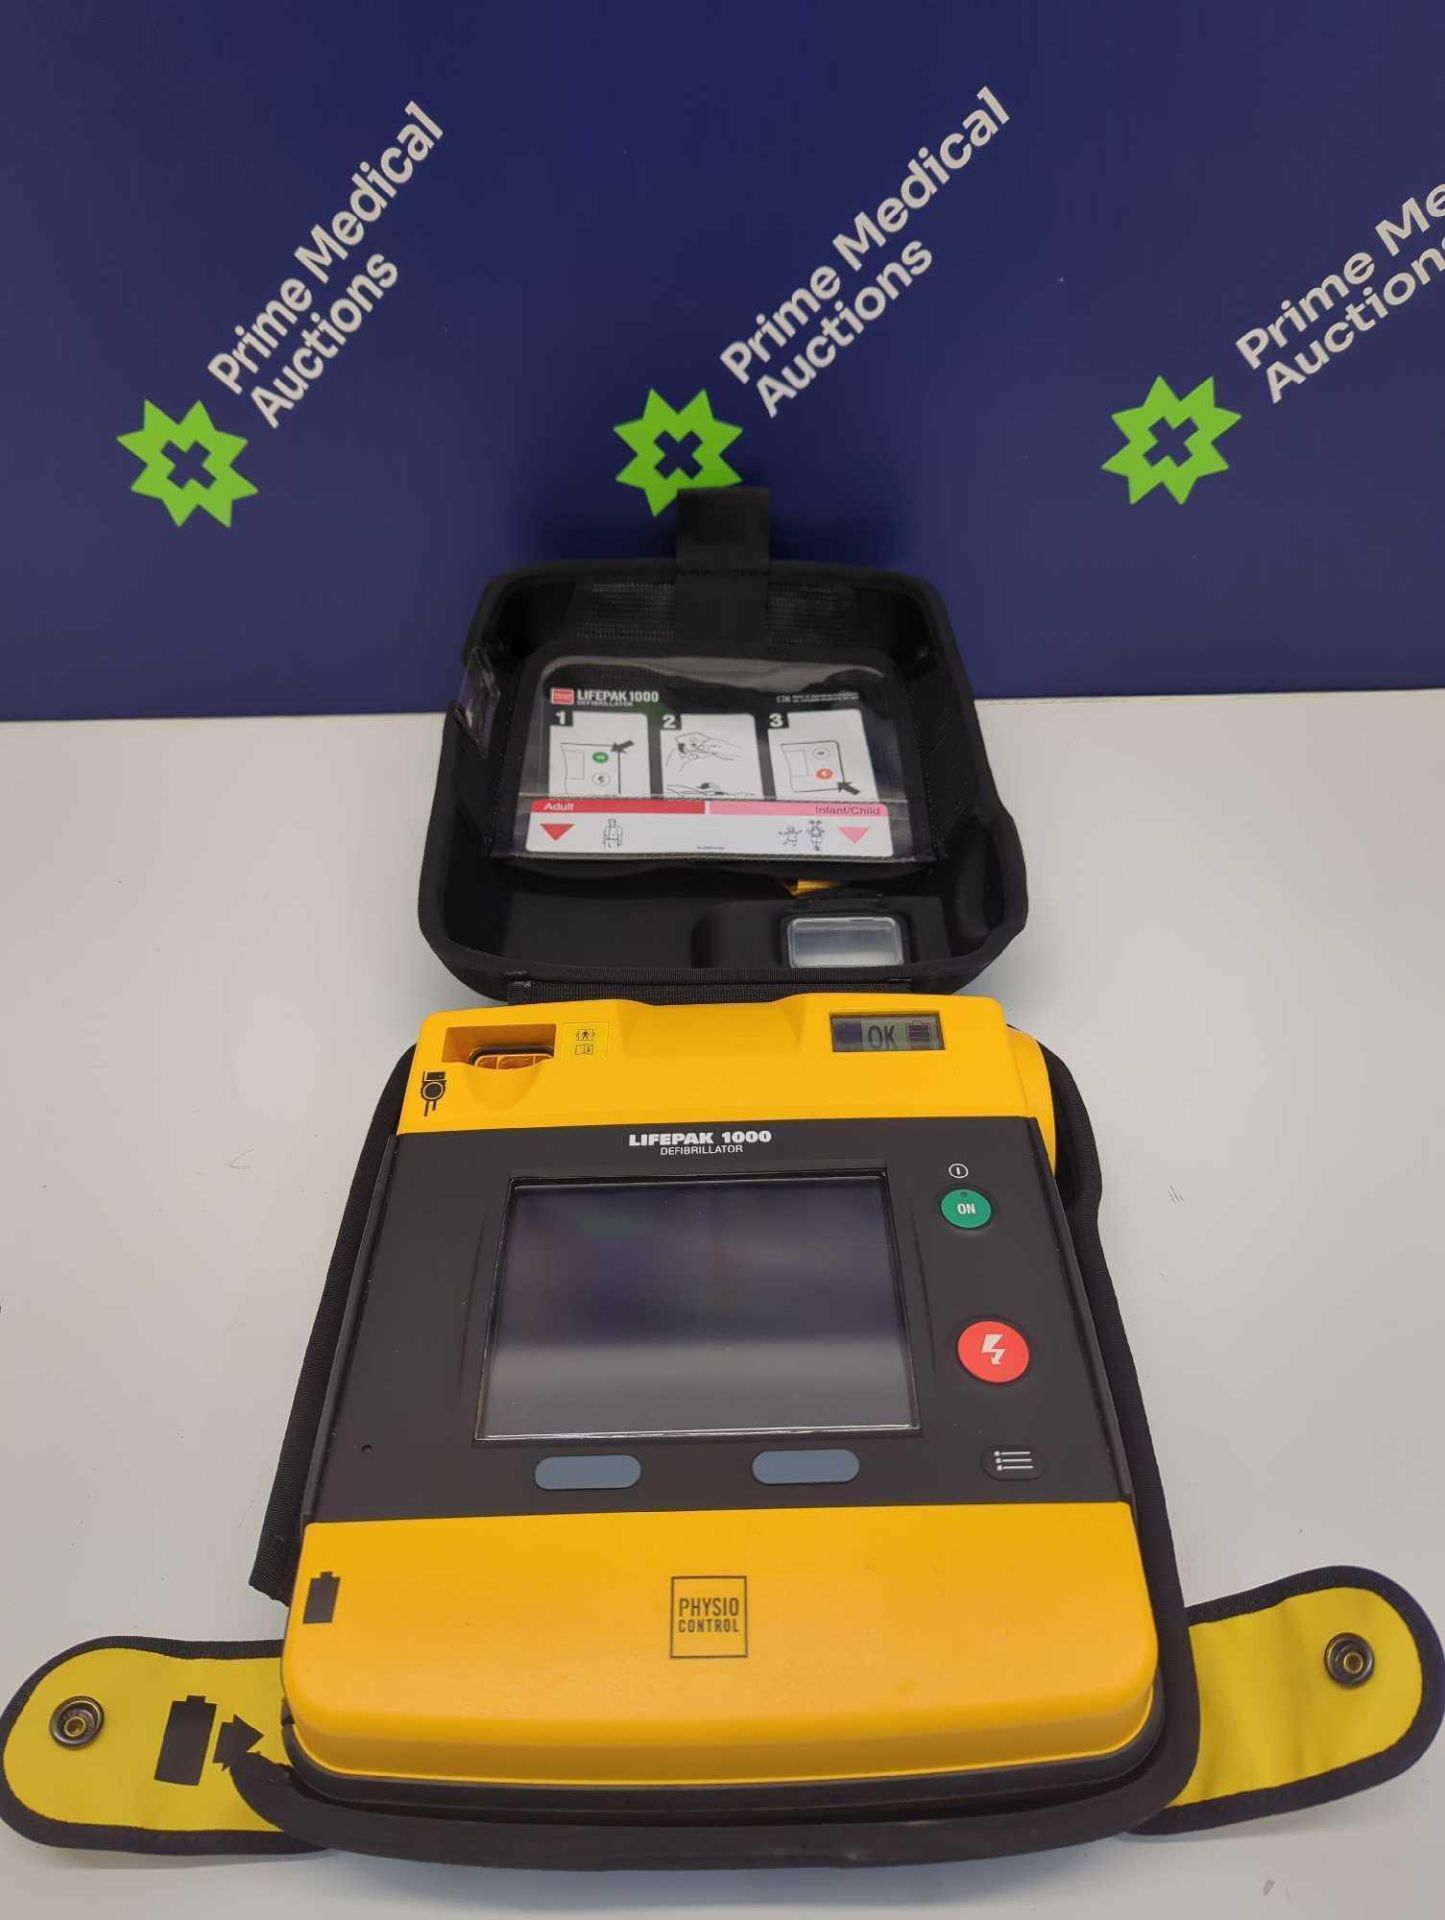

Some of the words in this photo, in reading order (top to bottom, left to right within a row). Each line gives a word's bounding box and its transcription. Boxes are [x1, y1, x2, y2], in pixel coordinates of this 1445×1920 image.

[720, 265, 841, 384] Prime
[833, 86, 1010, 271] Medical
[208, 278, 312, 395] Prime
[294, 101, 443, 284] Medical
[1235, 252, 1375, 370] Prime
[1266, 236, 1445, 404] Auction
[756, 240, 933, 418] Auctions
[250, 253, 399, 429] Auctions
[577, 689, 627, 701] LIFEPAK
[629, 690, 660, 702] 1000
[556, 710, 566, 725] 1
[662, 714, 677, 728] 2
[768, 713, 783, 727] 3
[543, 802, 574, 811] Adult
[815, 806, 880, 815] Infant/Child
[867, 1024, 897, 1050] OK
[628, 1132, 715, 1146] LIFEPAK
[721, 1130, 772, 1144] 1000
[660, 1144, 744, 1156] DEFIBRILLATOR
[957, 1203, 976, 1215] ON
[679, 1597, 739, 1617] PHYSIO
[678, 1618, 740, 1633] CONTROL
